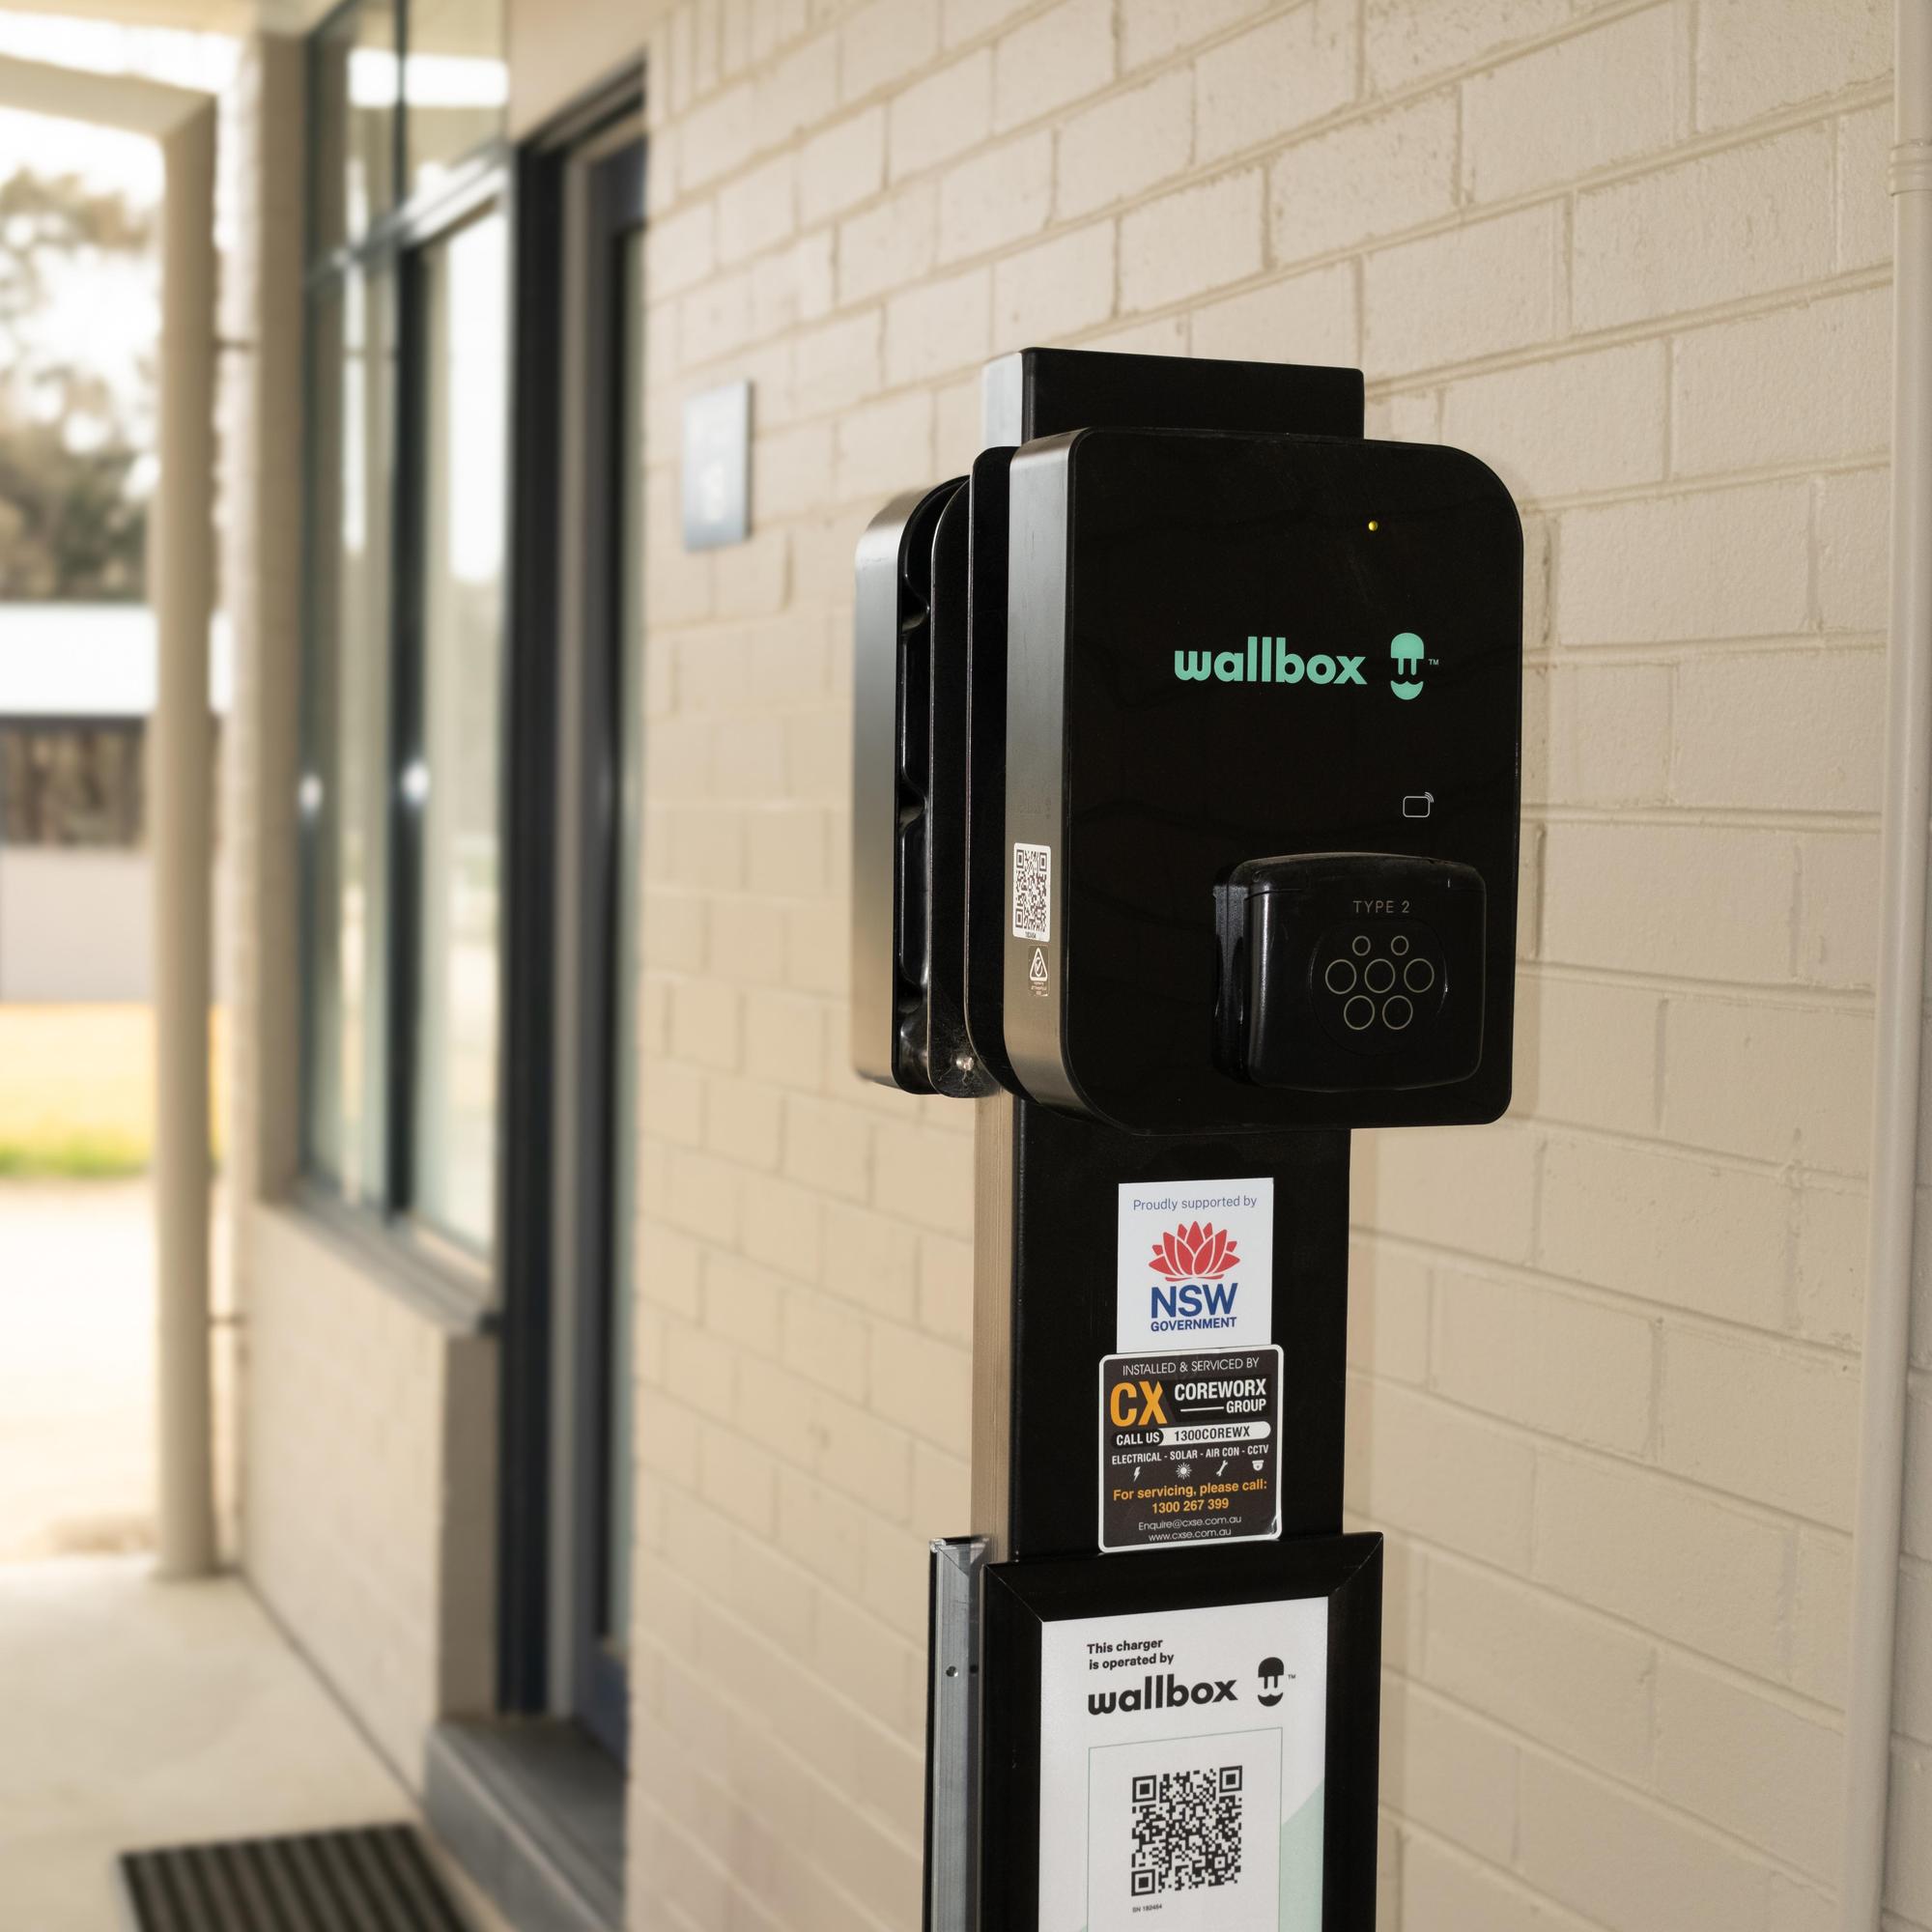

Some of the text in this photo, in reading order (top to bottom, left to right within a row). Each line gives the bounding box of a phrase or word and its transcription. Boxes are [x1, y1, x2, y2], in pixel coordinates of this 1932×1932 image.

[1174, 636, 1368, 685] wallbox
[1352, 900, 1410, 914] TYPE 2
[1133, 1195, 1258, 1211] Proudly supported by
[1151, 1282, 1238, 1319] NSW
[1151, 1317, 1237, 1332] GOVERNMENT
[1122, 1357, 1260, 1377] INSTALLED & SERVICED BY
[1174, 1378, 1266, 1401] COREWORX
[1110, 1380, 1168, 1428] CX
[1226, 1399, 1266, 1413] GROUP
[1116, 1426, 1251, 1446] CALL US 1300COREWX
[1112, 1452, 1162, 1465] ELECTRICAL
[1170, 1450, 1198, 1461] SOLAR
[1206, 1448, 1220, 1459] AIR
[1222, 1446, 1239, 1457] CON
[1247, 1444, 1269, 1455] CCTV
[1113, 1478, 1267, 1501] For servicing, please call:
[1152, 1497, 1229, 1514] 1300 267 399
[1138, 1515, 1242, 1531] Enquire@cxse.com.au
[1149, 1528, 1232, 1542] www.cxse.com.au
[1087, 1639, 1163, 1655] This charger
[1089, 1653, 1175, 1670] is operated by
[1088, 1673, 1238, 1716] wallbox
